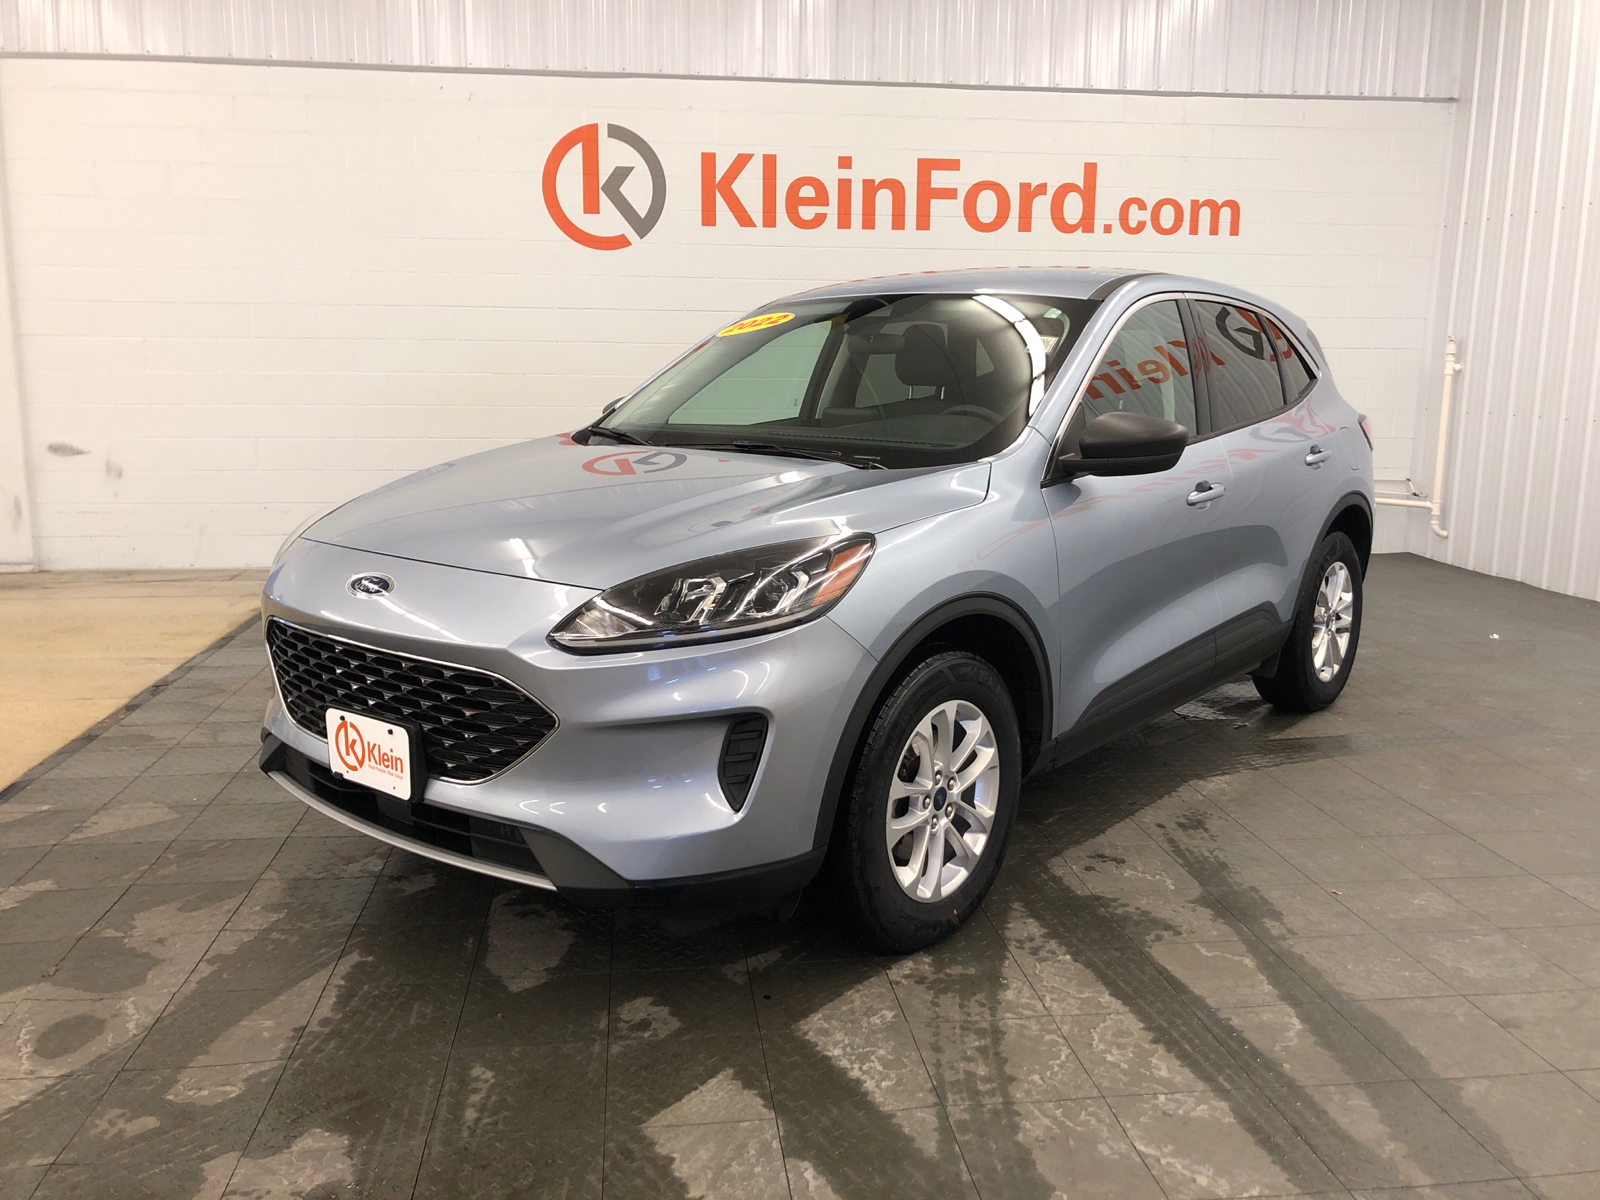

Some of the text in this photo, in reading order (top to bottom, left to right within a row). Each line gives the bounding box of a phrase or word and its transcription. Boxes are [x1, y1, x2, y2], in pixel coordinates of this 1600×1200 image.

[700, 151, 1241, 237] KleinFord.com
[720, 314, 790, 335] 2022
[367, 740, 404, 774] Klein
